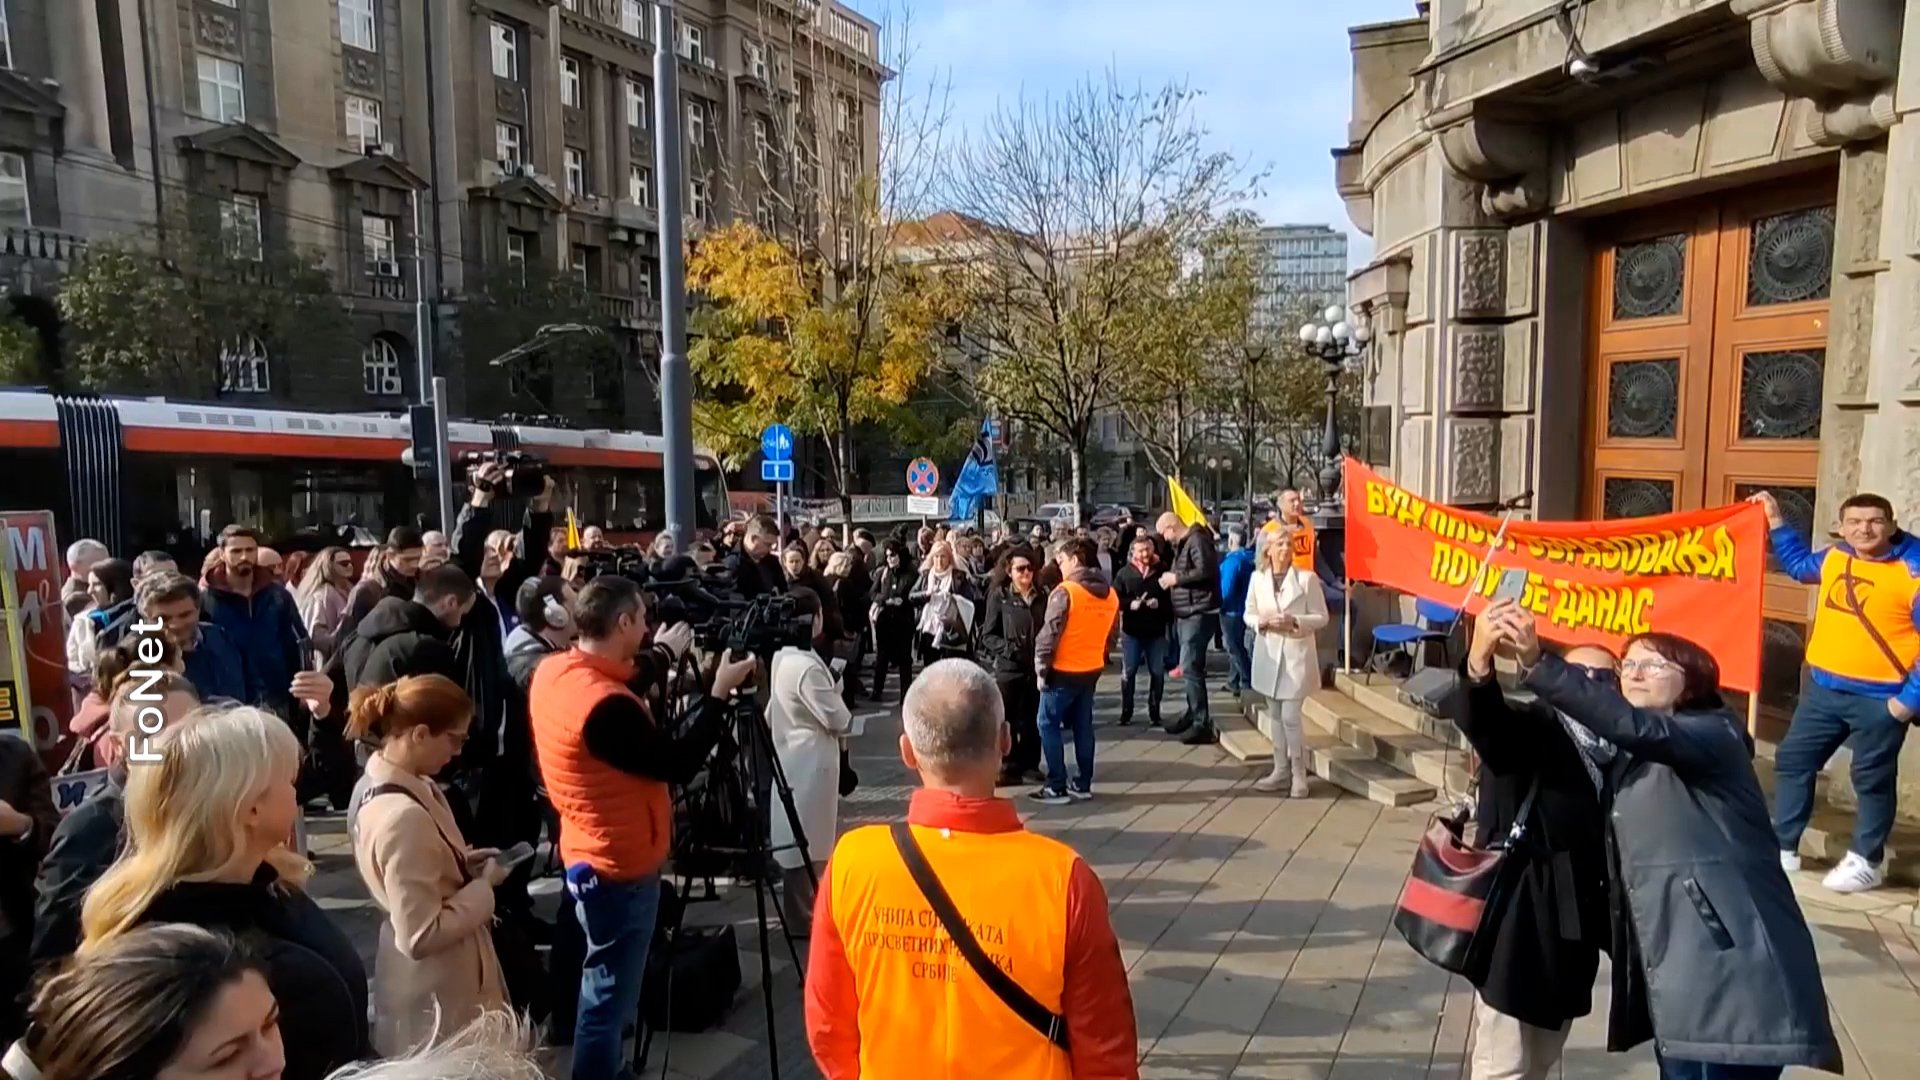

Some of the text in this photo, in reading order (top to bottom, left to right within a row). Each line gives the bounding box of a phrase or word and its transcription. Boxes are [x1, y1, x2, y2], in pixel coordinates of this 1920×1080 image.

[1366, 480, 1515, 551] БУДУЋНО
[1550, 579, 1655, 635] ДАНАС
[874, 906, 1004, 945] УНИЈА СИАТА
[912, 962, 957, 982] СРБИЈЕ
